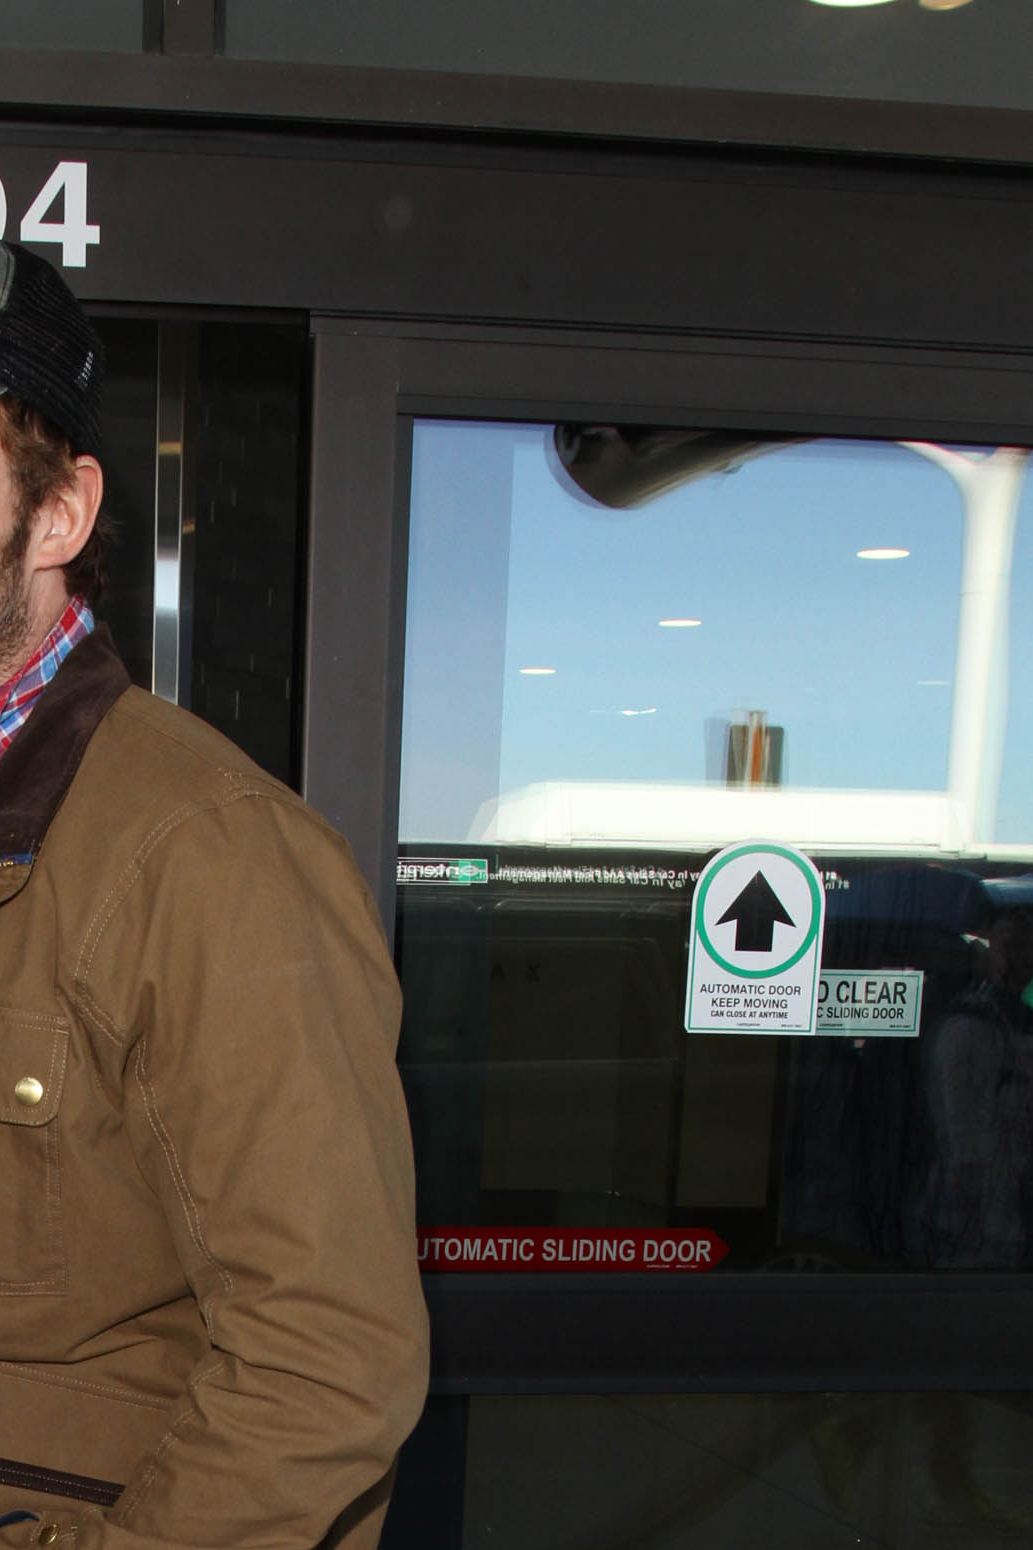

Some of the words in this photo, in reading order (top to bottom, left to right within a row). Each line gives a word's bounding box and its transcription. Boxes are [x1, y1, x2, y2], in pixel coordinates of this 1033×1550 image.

[700, 983, 765, 996] AUTOMATIC
[768, 985, 801, 996] DOOR
[835, 980, 907, 1005] CLEAR
[711, 998, 741, 1008] KEEP
[743, 999, 788, 1009] MOVING
[710, 1010, 724, 1018] CAN
[726, 1010, 747, 1018] CLOSE
[748, 1010, 757, 1018] AT
[759, 1010, 789, 1019] ANYTIME
[826, 1007, 870, 1019] SLIDING
[872, 1007, 904, 1020] DOOR
[416, 1238, 535, 1261] UTOMATIC
[541, 1238, 636, 1262] SLIDING
[643, 1239, 711, 1262] DOOR
